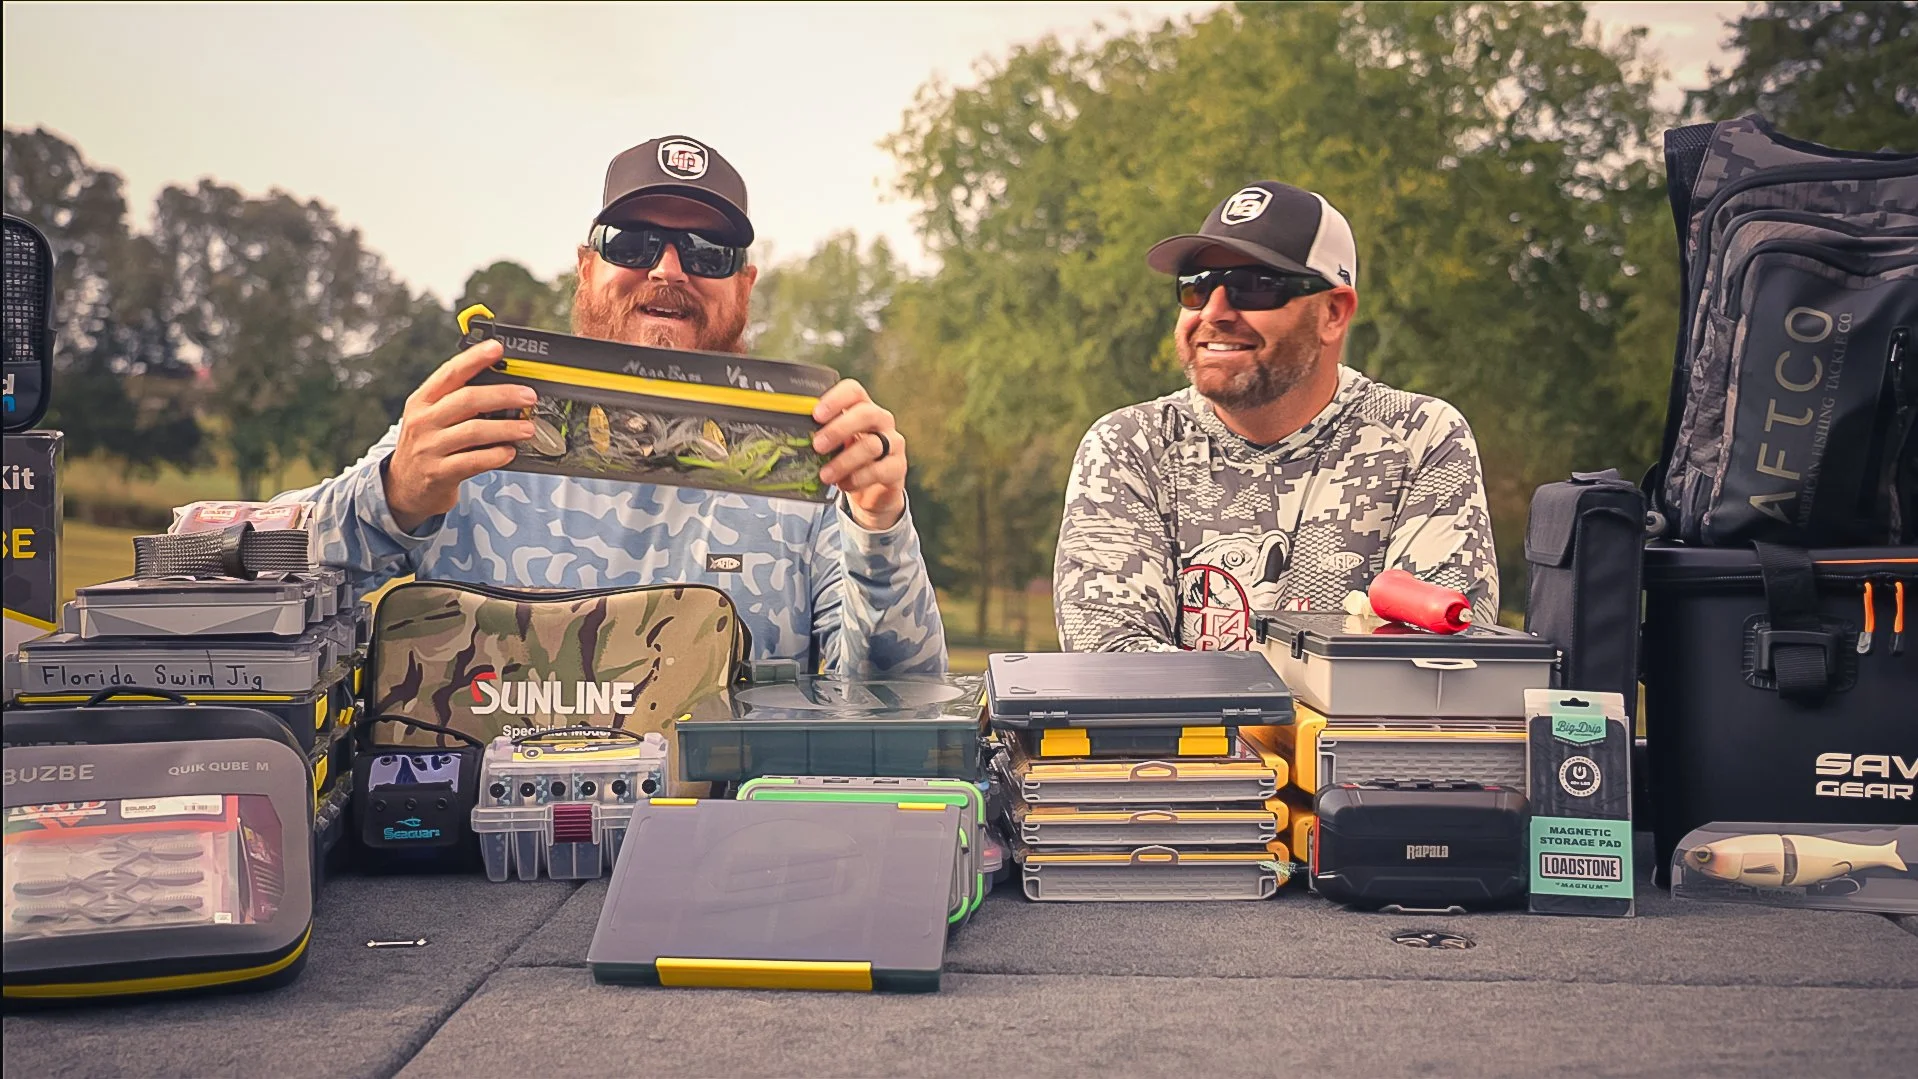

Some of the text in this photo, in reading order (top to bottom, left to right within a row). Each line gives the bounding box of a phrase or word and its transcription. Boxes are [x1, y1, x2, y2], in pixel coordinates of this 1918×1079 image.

[1811, 396, 1836, 457] FISHING
[1826, 334, 1848, 391] TACKLE
[1749, 306, 1833, 525] AFTCO
[42, 664, 263, 691] Florida Swim Jig
[470, 671, 636, 715] SUNLINE
[3, 764, 95, 786] BUZBE
[168, 761, 269, 776] QUIK QUBE M
[1816, 752, 1918, 779] SAV
[1816, 780, 1914, 801] GEAR
[1539, 836, 1622, 848] STORAGE PAD
[1549, 826, 1612, 837] MAGNETIC
[1544, 856, 1617, 877] LOADSTONE
